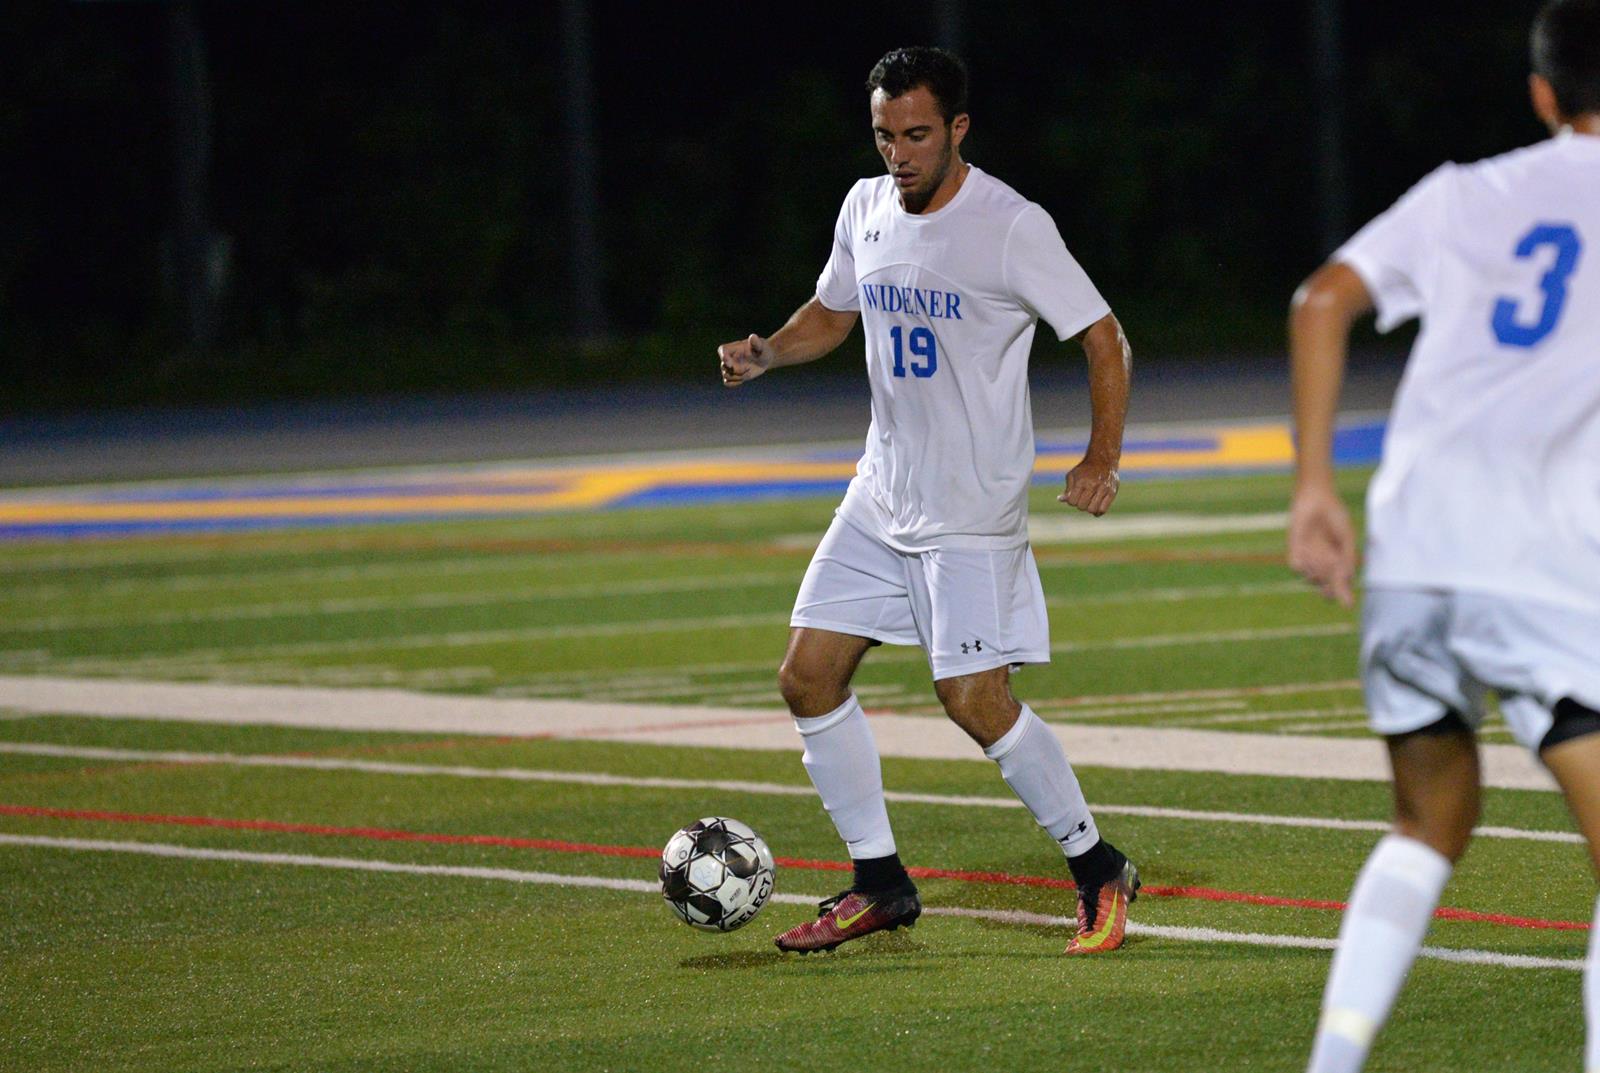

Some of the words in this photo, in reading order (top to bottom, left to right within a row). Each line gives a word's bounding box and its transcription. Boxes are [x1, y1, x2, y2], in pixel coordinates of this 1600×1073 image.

[862, 283, 963, 321] WIDENER
[1491, 222, 1581, 348] 3
[890, 325, 938, 378] 19
[729, 877, 771, 928] SELECT
